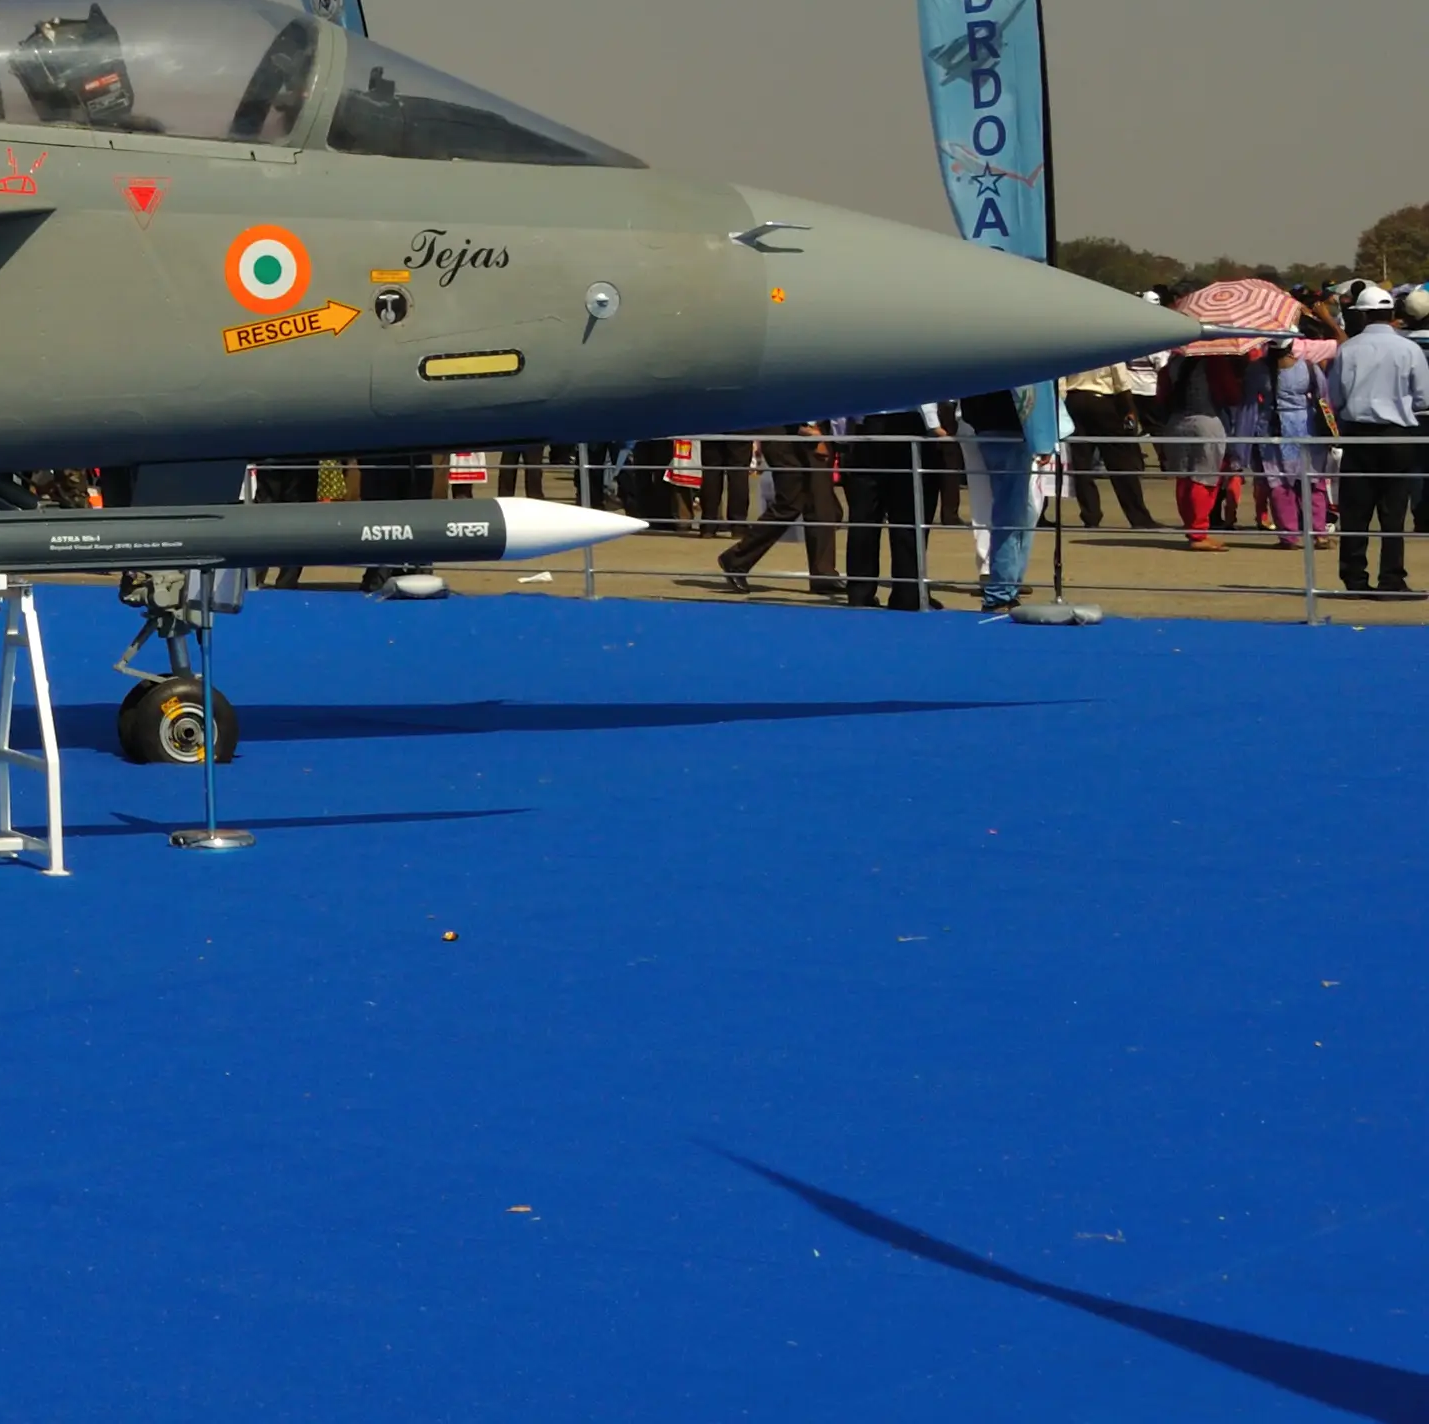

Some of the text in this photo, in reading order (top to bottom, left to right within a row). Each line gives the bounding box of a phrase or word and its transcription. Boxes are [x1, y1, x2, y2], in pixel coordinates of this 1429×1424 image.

[403, 229, 510, 287] Tejas
[237, 313, 322, 347] RESCUE
[361, 525, 413, 541] ASTRA
[445, 521, 490, 538] अस्त्र
[50, 535, 81, 543] ASTRA
